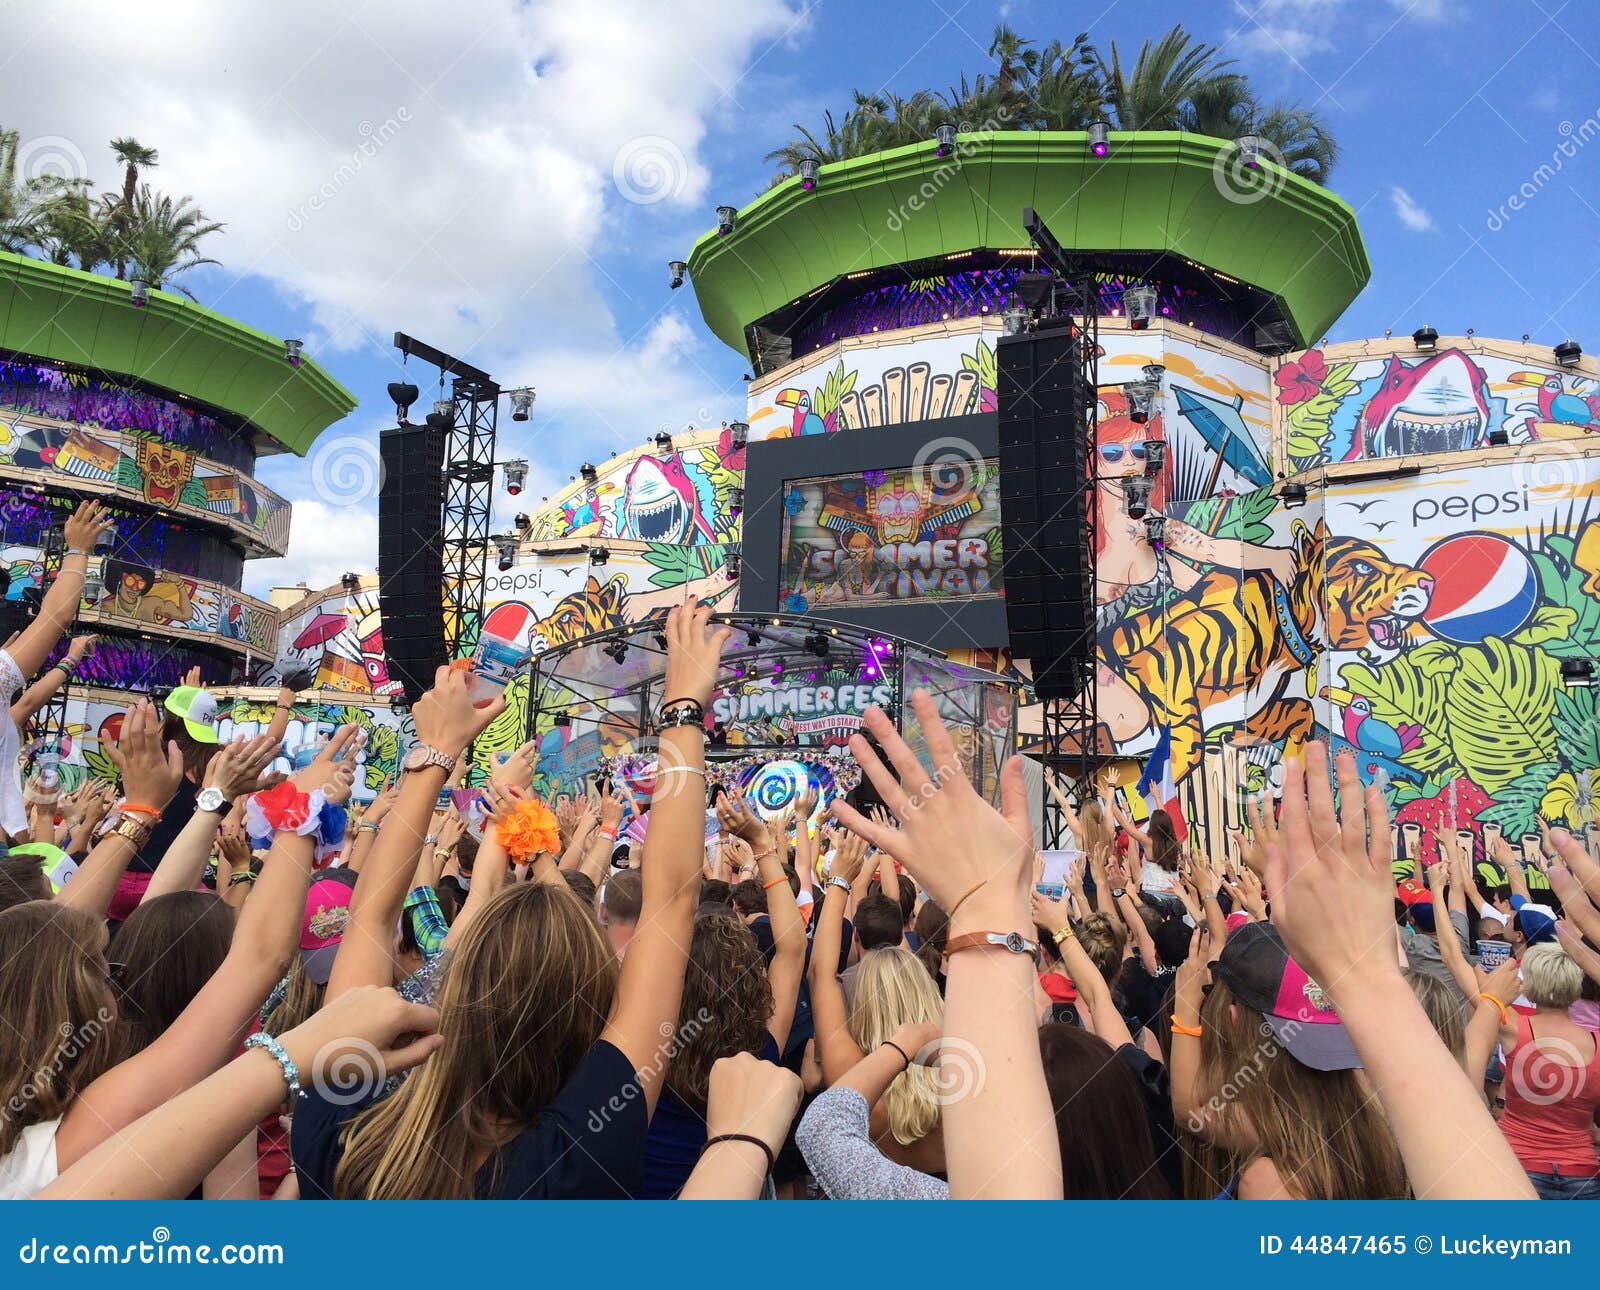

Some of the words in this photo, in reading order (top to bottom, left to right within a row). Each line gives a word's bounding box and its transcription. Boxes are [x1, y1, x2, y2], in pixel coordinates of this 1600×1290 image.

[1412, 484, 1529, 527] pepsi
[485, 569, 542, 596] pepsi
[713, 685, 899, 723] SUMMERFES
[812, 719, 826, 730] WAY
[827, 718, 835, 727] TO
[837, 717, 857, 727] START
